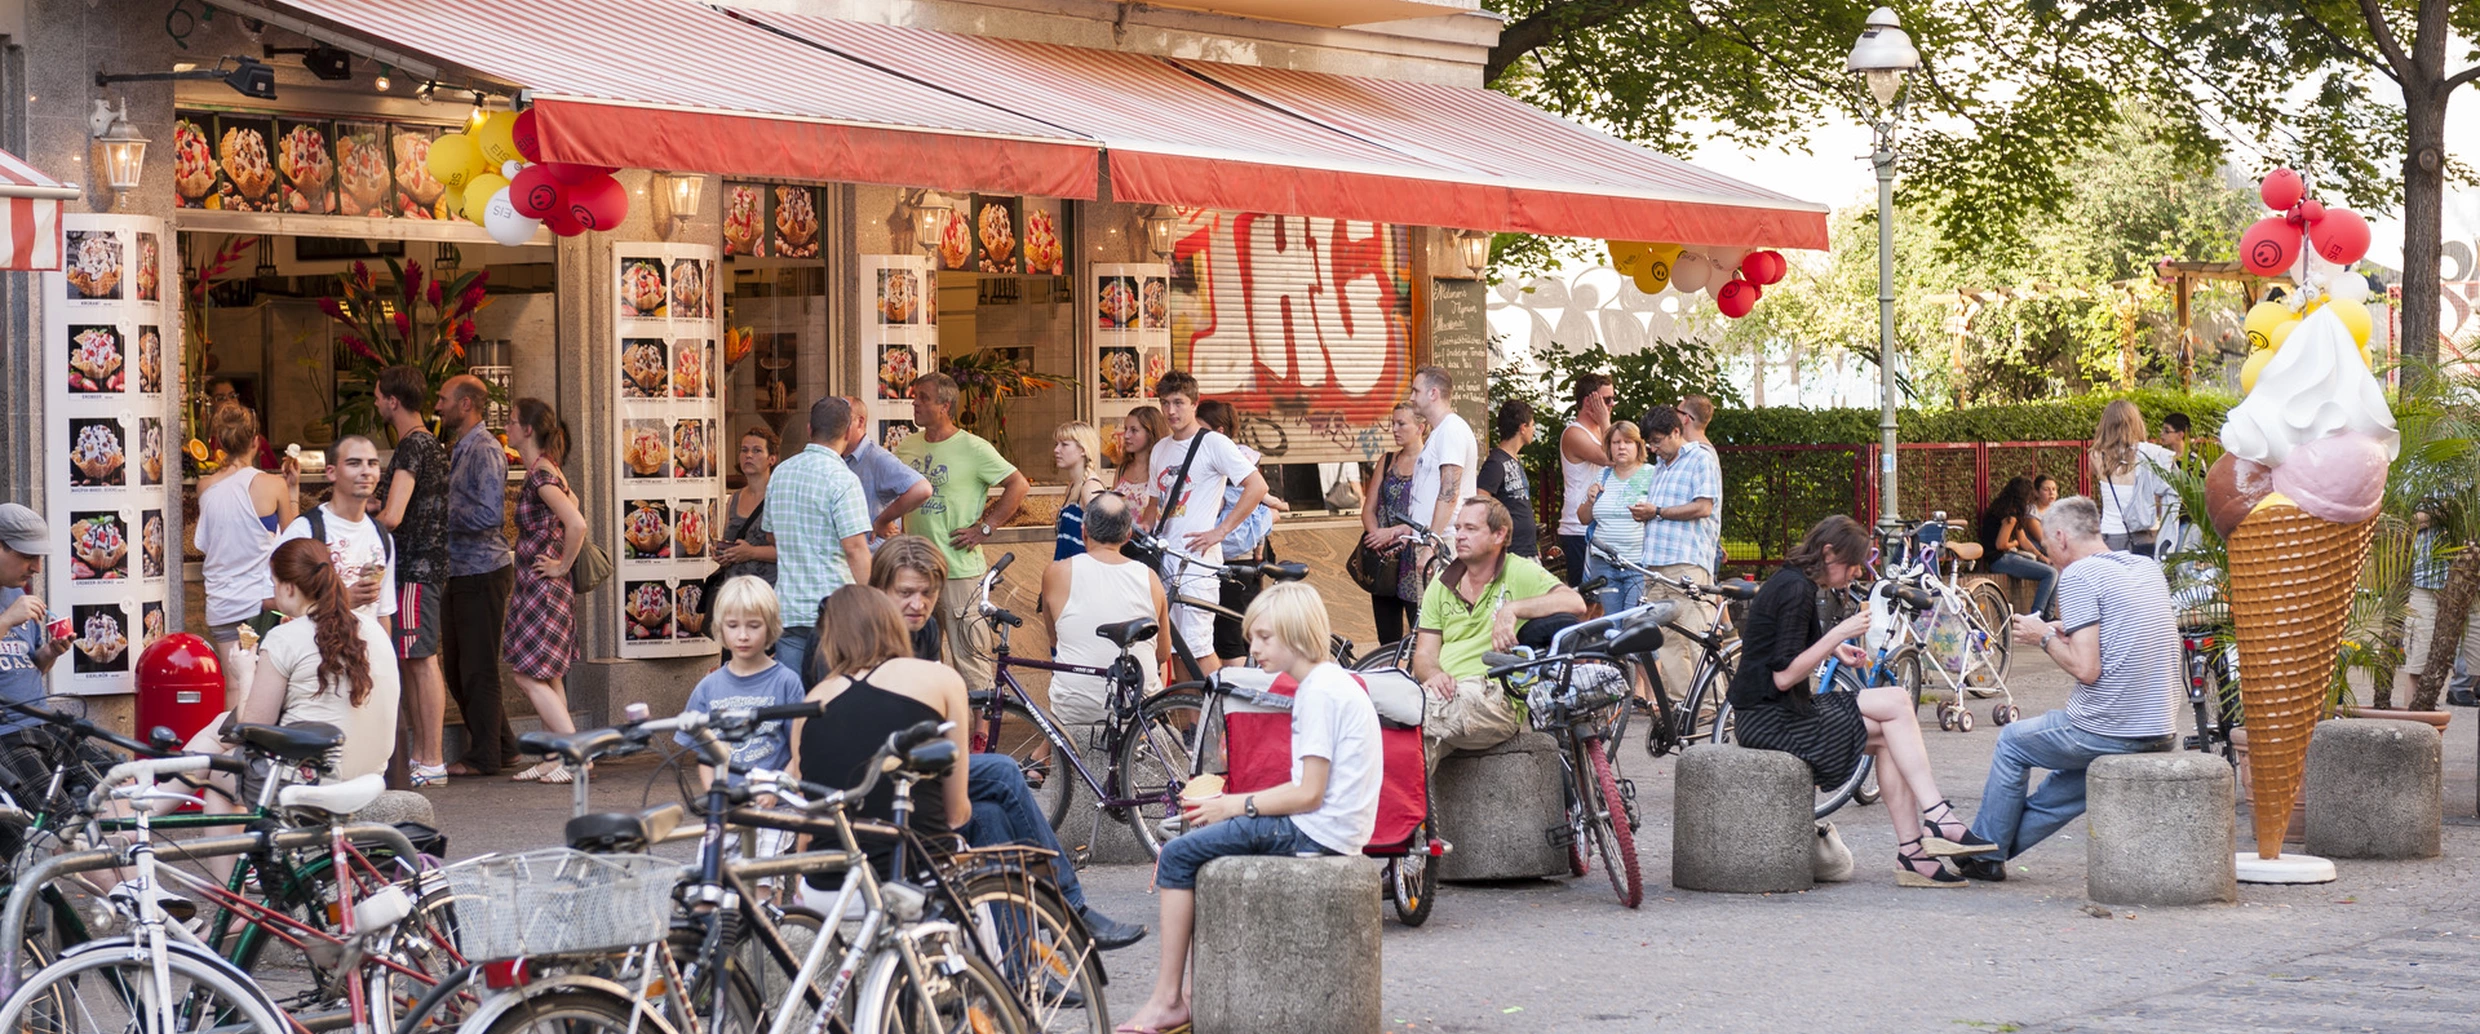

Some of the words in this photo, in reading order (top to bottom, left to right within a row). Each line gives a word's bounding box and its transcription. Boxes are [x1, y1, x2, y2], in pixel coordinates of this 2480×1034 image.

[517, 133, 536, 152] EIS
[490, 143, 511, 161] EIS
[448, 172, 462, 187] EIS
[493, 205, 513, 219] EIS
[2327, 243, 2343, 261] EIS
[1025, 701, 1063, 747] WHEELER
